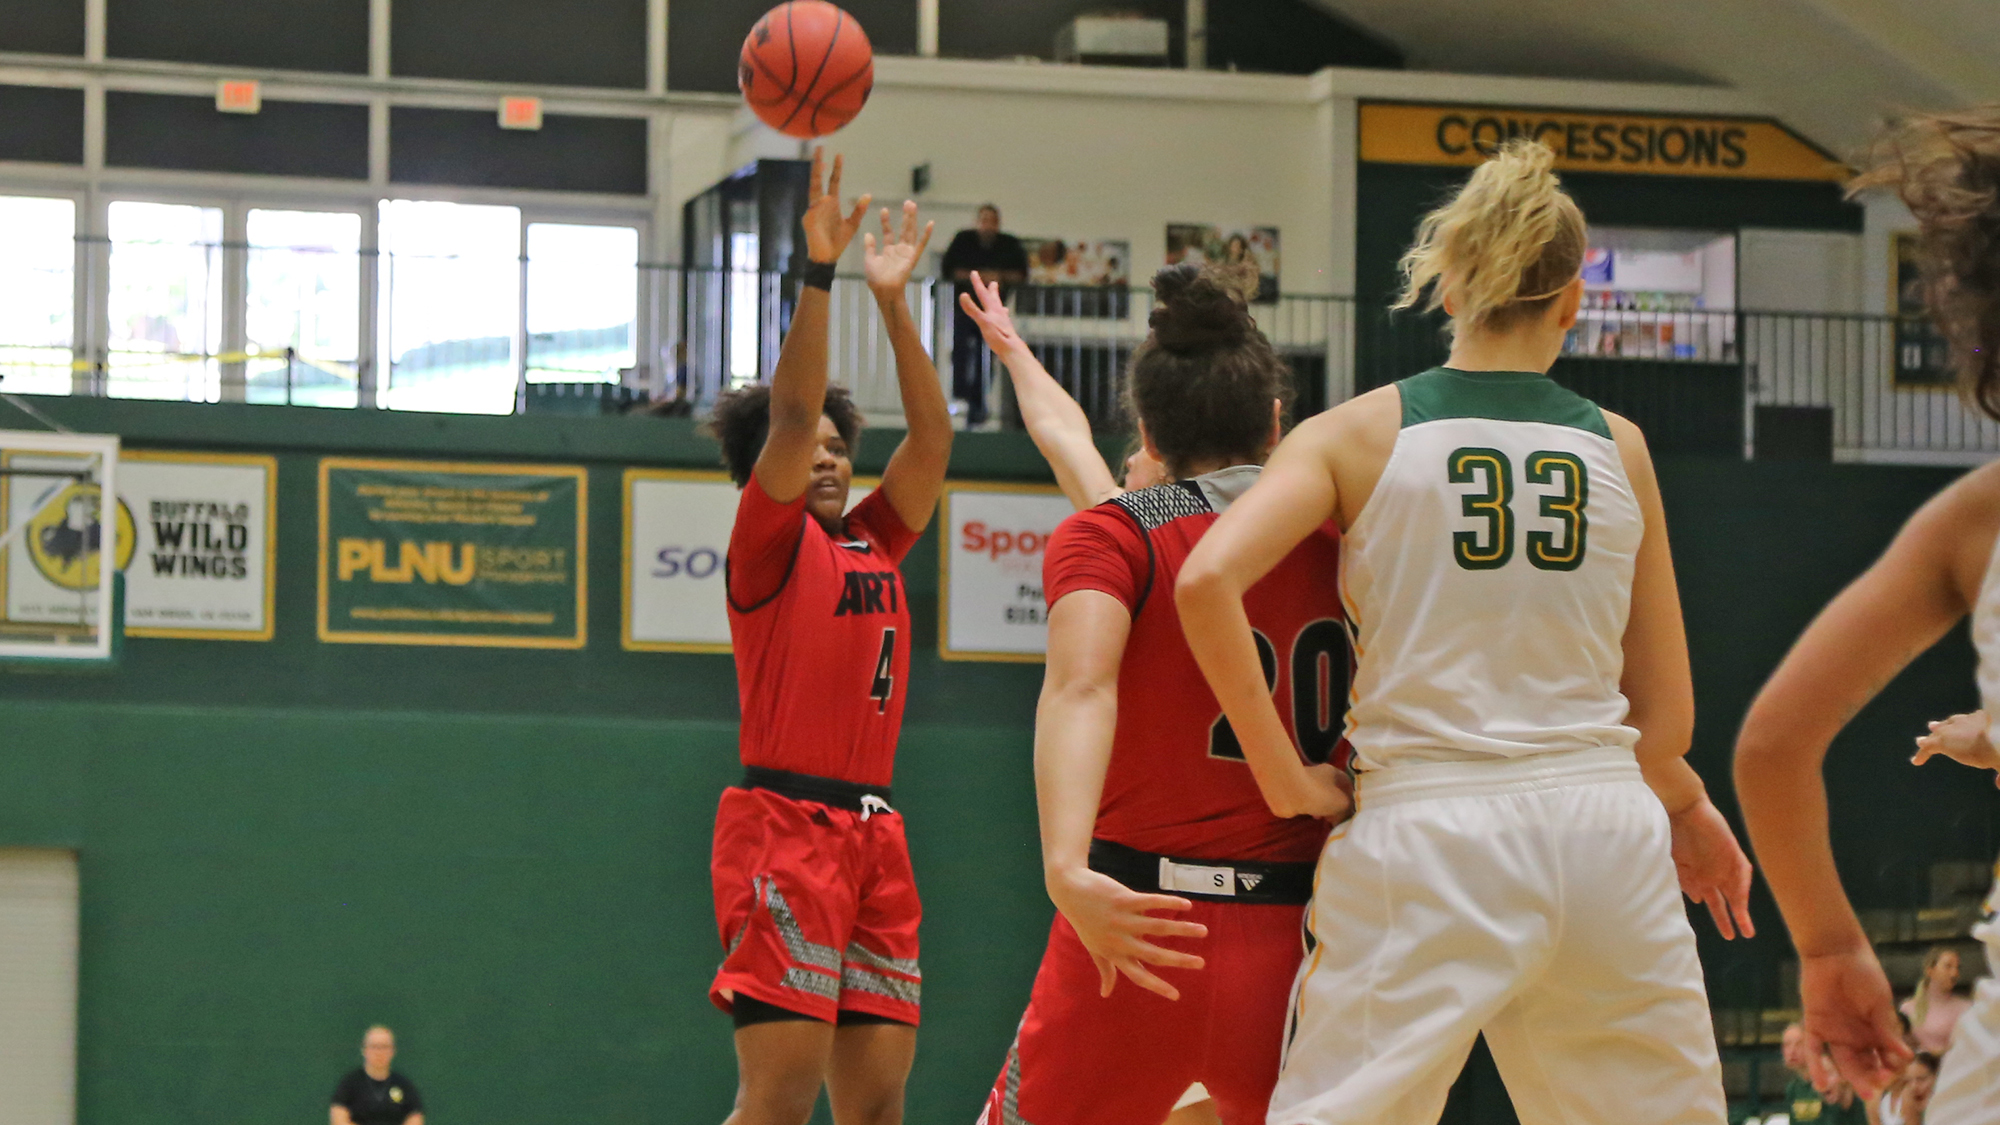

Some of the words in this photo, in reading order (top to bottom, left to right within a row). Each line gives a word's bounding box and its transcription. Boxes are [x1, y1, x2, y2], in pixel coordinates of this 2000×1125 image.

[1437, 114, 1748, 168] CONCESSIONS
[150, 501, 249, 523] BUFFALO
[1447, 447, 1589, 571] 33
[155, 521, 248, 551] WILD
[151, 553, 248, 579] WINGS
[338, 539, 475, 585] PLNU
[652, 546, 726, 579] SO
[834, 570, 898, 617] ART
[869, 627, 897, 715] 4
[1213, 873, 1225, 888] S
